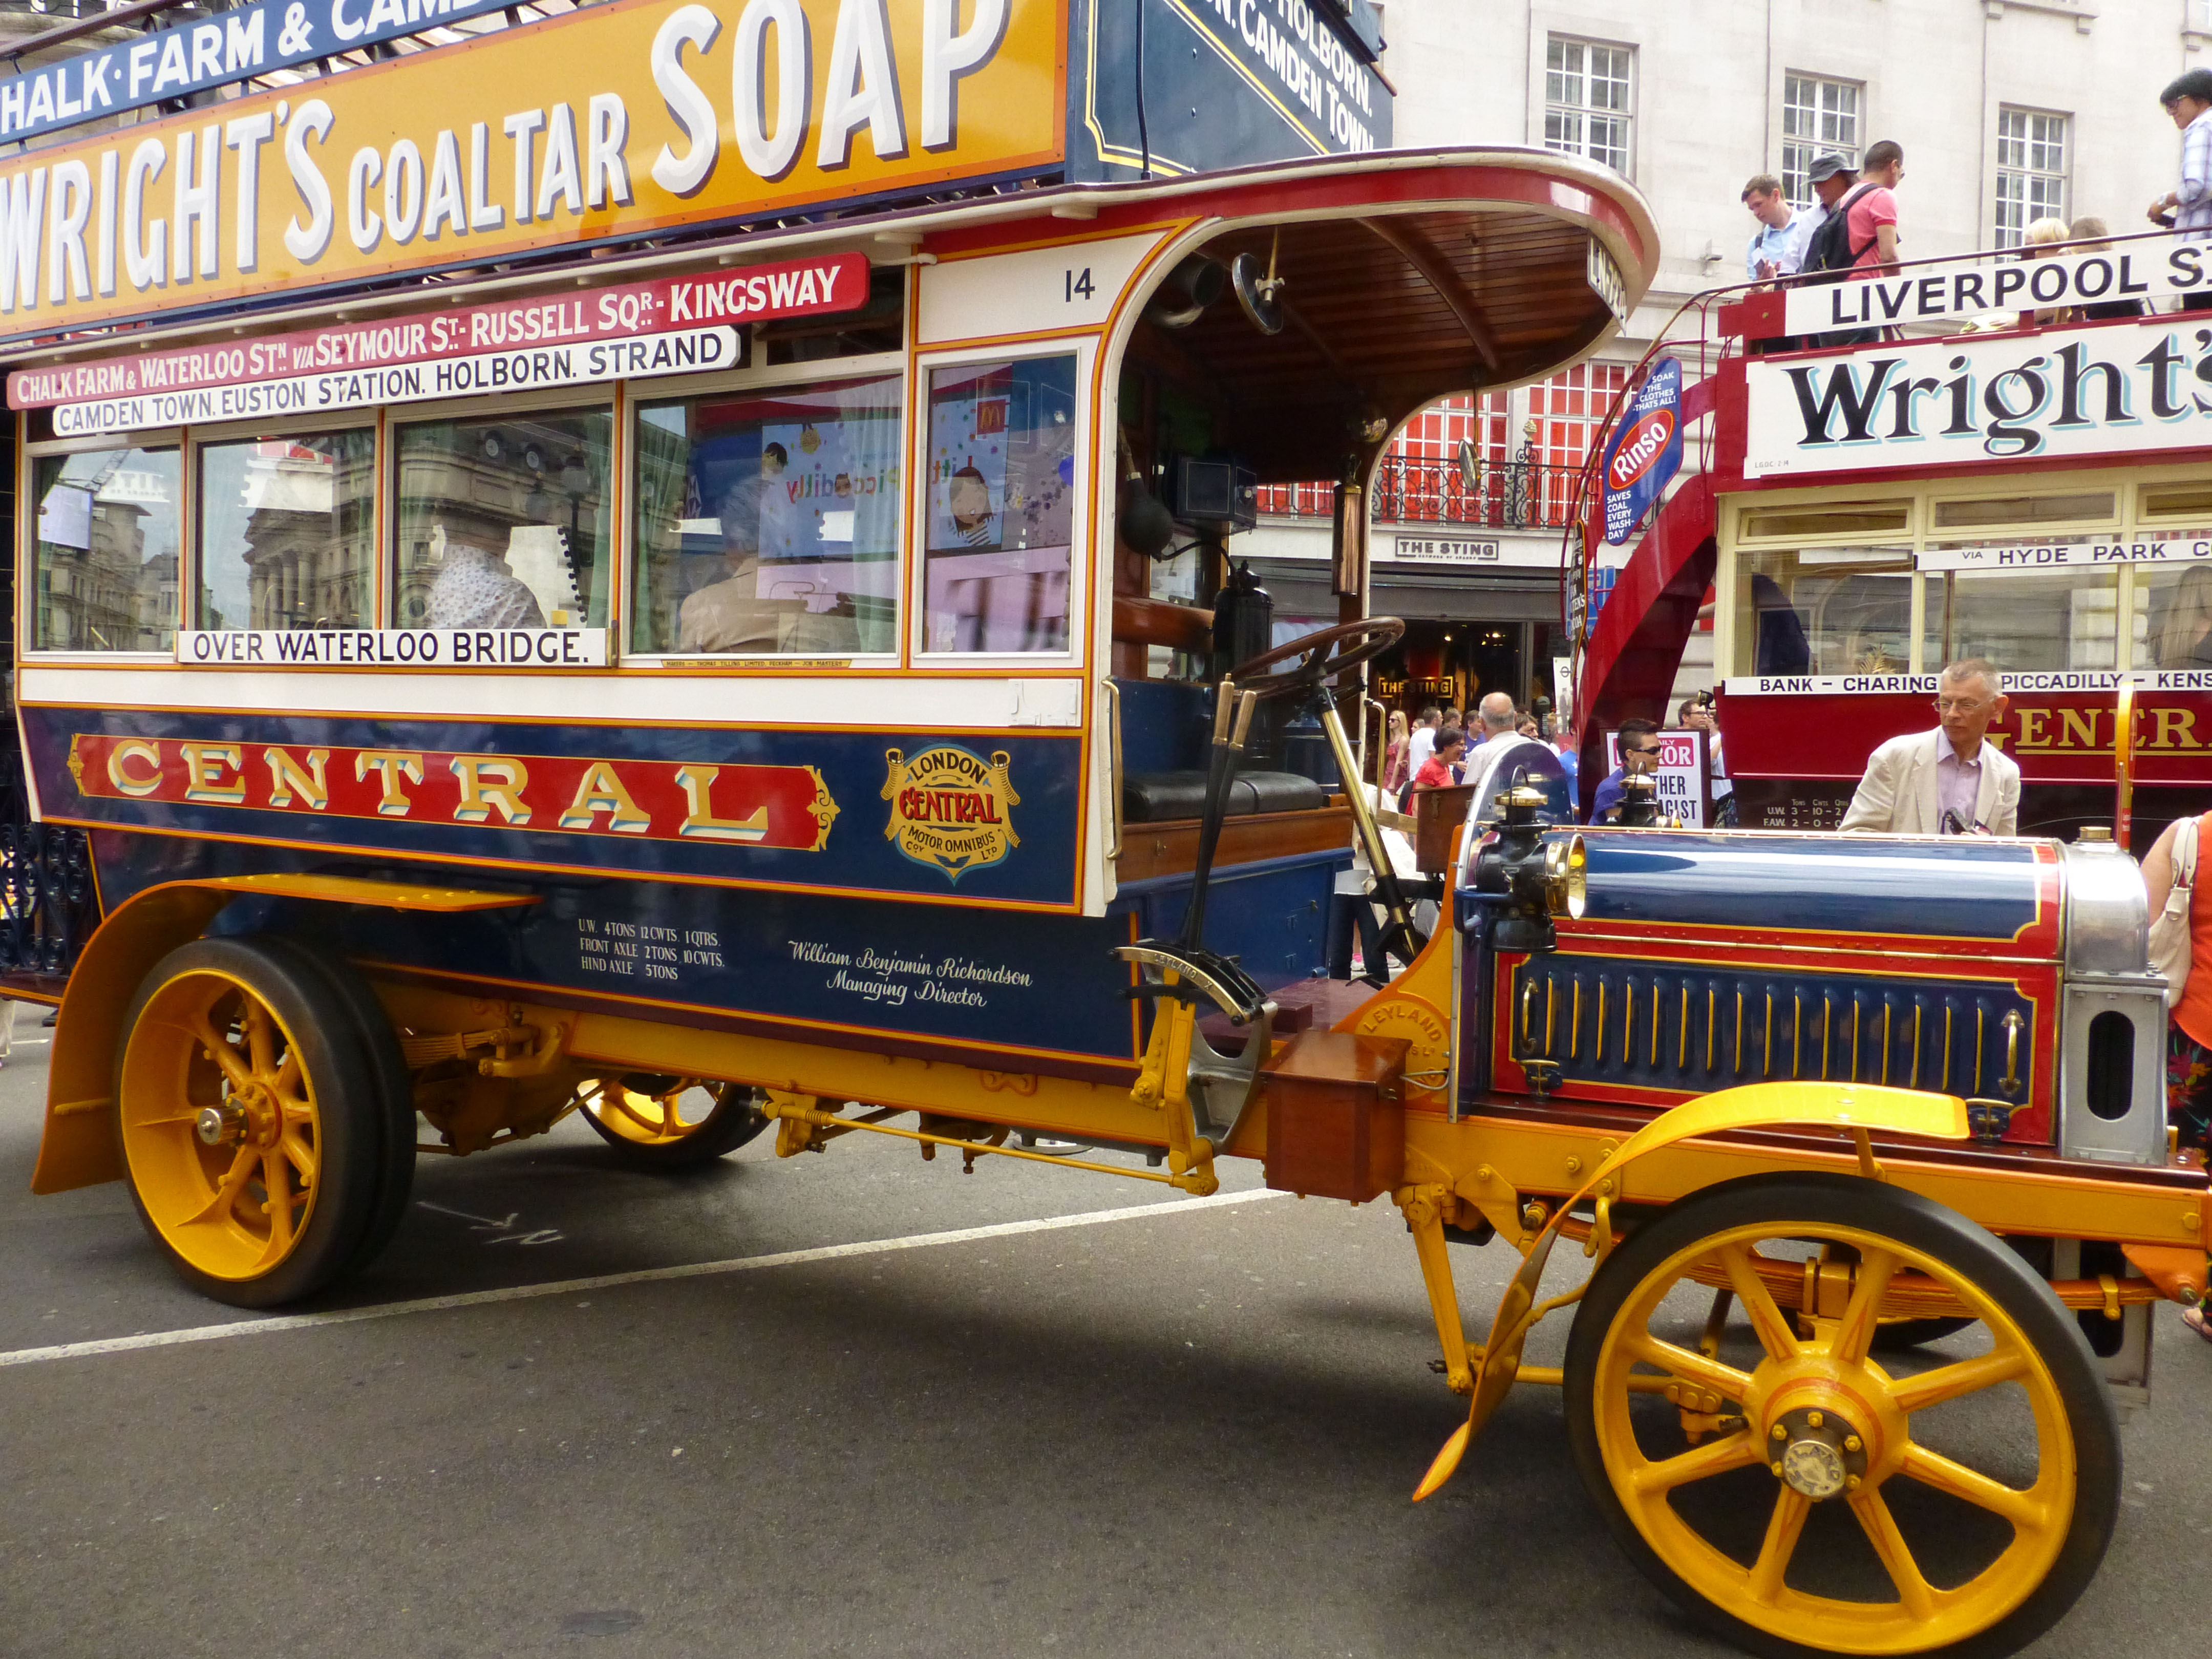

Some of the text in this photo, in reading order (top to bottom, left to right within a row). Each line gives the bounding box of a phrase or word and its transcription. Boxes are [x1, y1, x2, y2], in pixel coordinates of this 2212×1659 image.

[278, 1, 314, 57] &
[1240, 0, 1322, 120] CAMDEN
[0, 0, 1009, 314] WRIGHT'S COALTAR SOAP
[1065, 267, 1096, 303] 14
[1831, 246, 2212, 325] LIVERPOOL S
[17, 372, 73, 403] CHALK
[76, 365, 125, 396] FARM
[126, 370, 136, 390] &
[139, 349, 244, 389] WATERLOO
[293, 345, 314, 370] VIA
[315, 323, 428, 366] SEYMOUR
[471, 301, 590, 347] RUSSELL
[670, 265, 841, 323] KINGSWAY
[59, 333, 723, 431] CAMDEN TOWN. EUSTON STATION. HOLBORN. STRAND
[1647, 383, 1662, 393] THE
[1652, 372, 1674, 383] SOAK
[1640, 388, 1674, 402] CLOTHES
[1660, 395, 1676, 406] ALL!
[1613, 422, 1667, 482] Rinso
[1607, 490, 1631, 504] SAVES
[1607, 504, 1627, 513] COAL
[1607, 509, 1632, 522] EVERY
[1608, 529, 1624, 540] DAY
[1400, 541, 1494, 556] THE STING
[1962, 541, 2212, 565] VIA HYDE PARK C
[194, 632, 589, 663] OVER WATERLOO BRIDGE.
[1381, 682, 1405, 693] THE
[1760, 678, 1813, 692] BANK
[1843, 676, 1938, 691] CHARING
[2002, 673, 2124, 690] PICCADILLY
[909, 752, 987, 784] LONDON
[108, 739, 769, 841] CENTRAL
[899, 786, 1003, 824] CENTRAL
[908, 825, 995, 853] MOTOR OMNIBUS
[579, 919, 598, 933] U.W.
[580, 938, 609, 954] FRONT
[614, 942, 639, 958] AXLE
[581, 956, 607, 971] HIND
[609, 960, 634, 975] AXLE
[788, 940, 1033, 987] William Benjamin Richardson
[1154, 953, 1197, 979] LEYLAND
[826, 969, 987, 1007] Managing Director
[1363, 1004, 1442, 1041] LEYLAND
